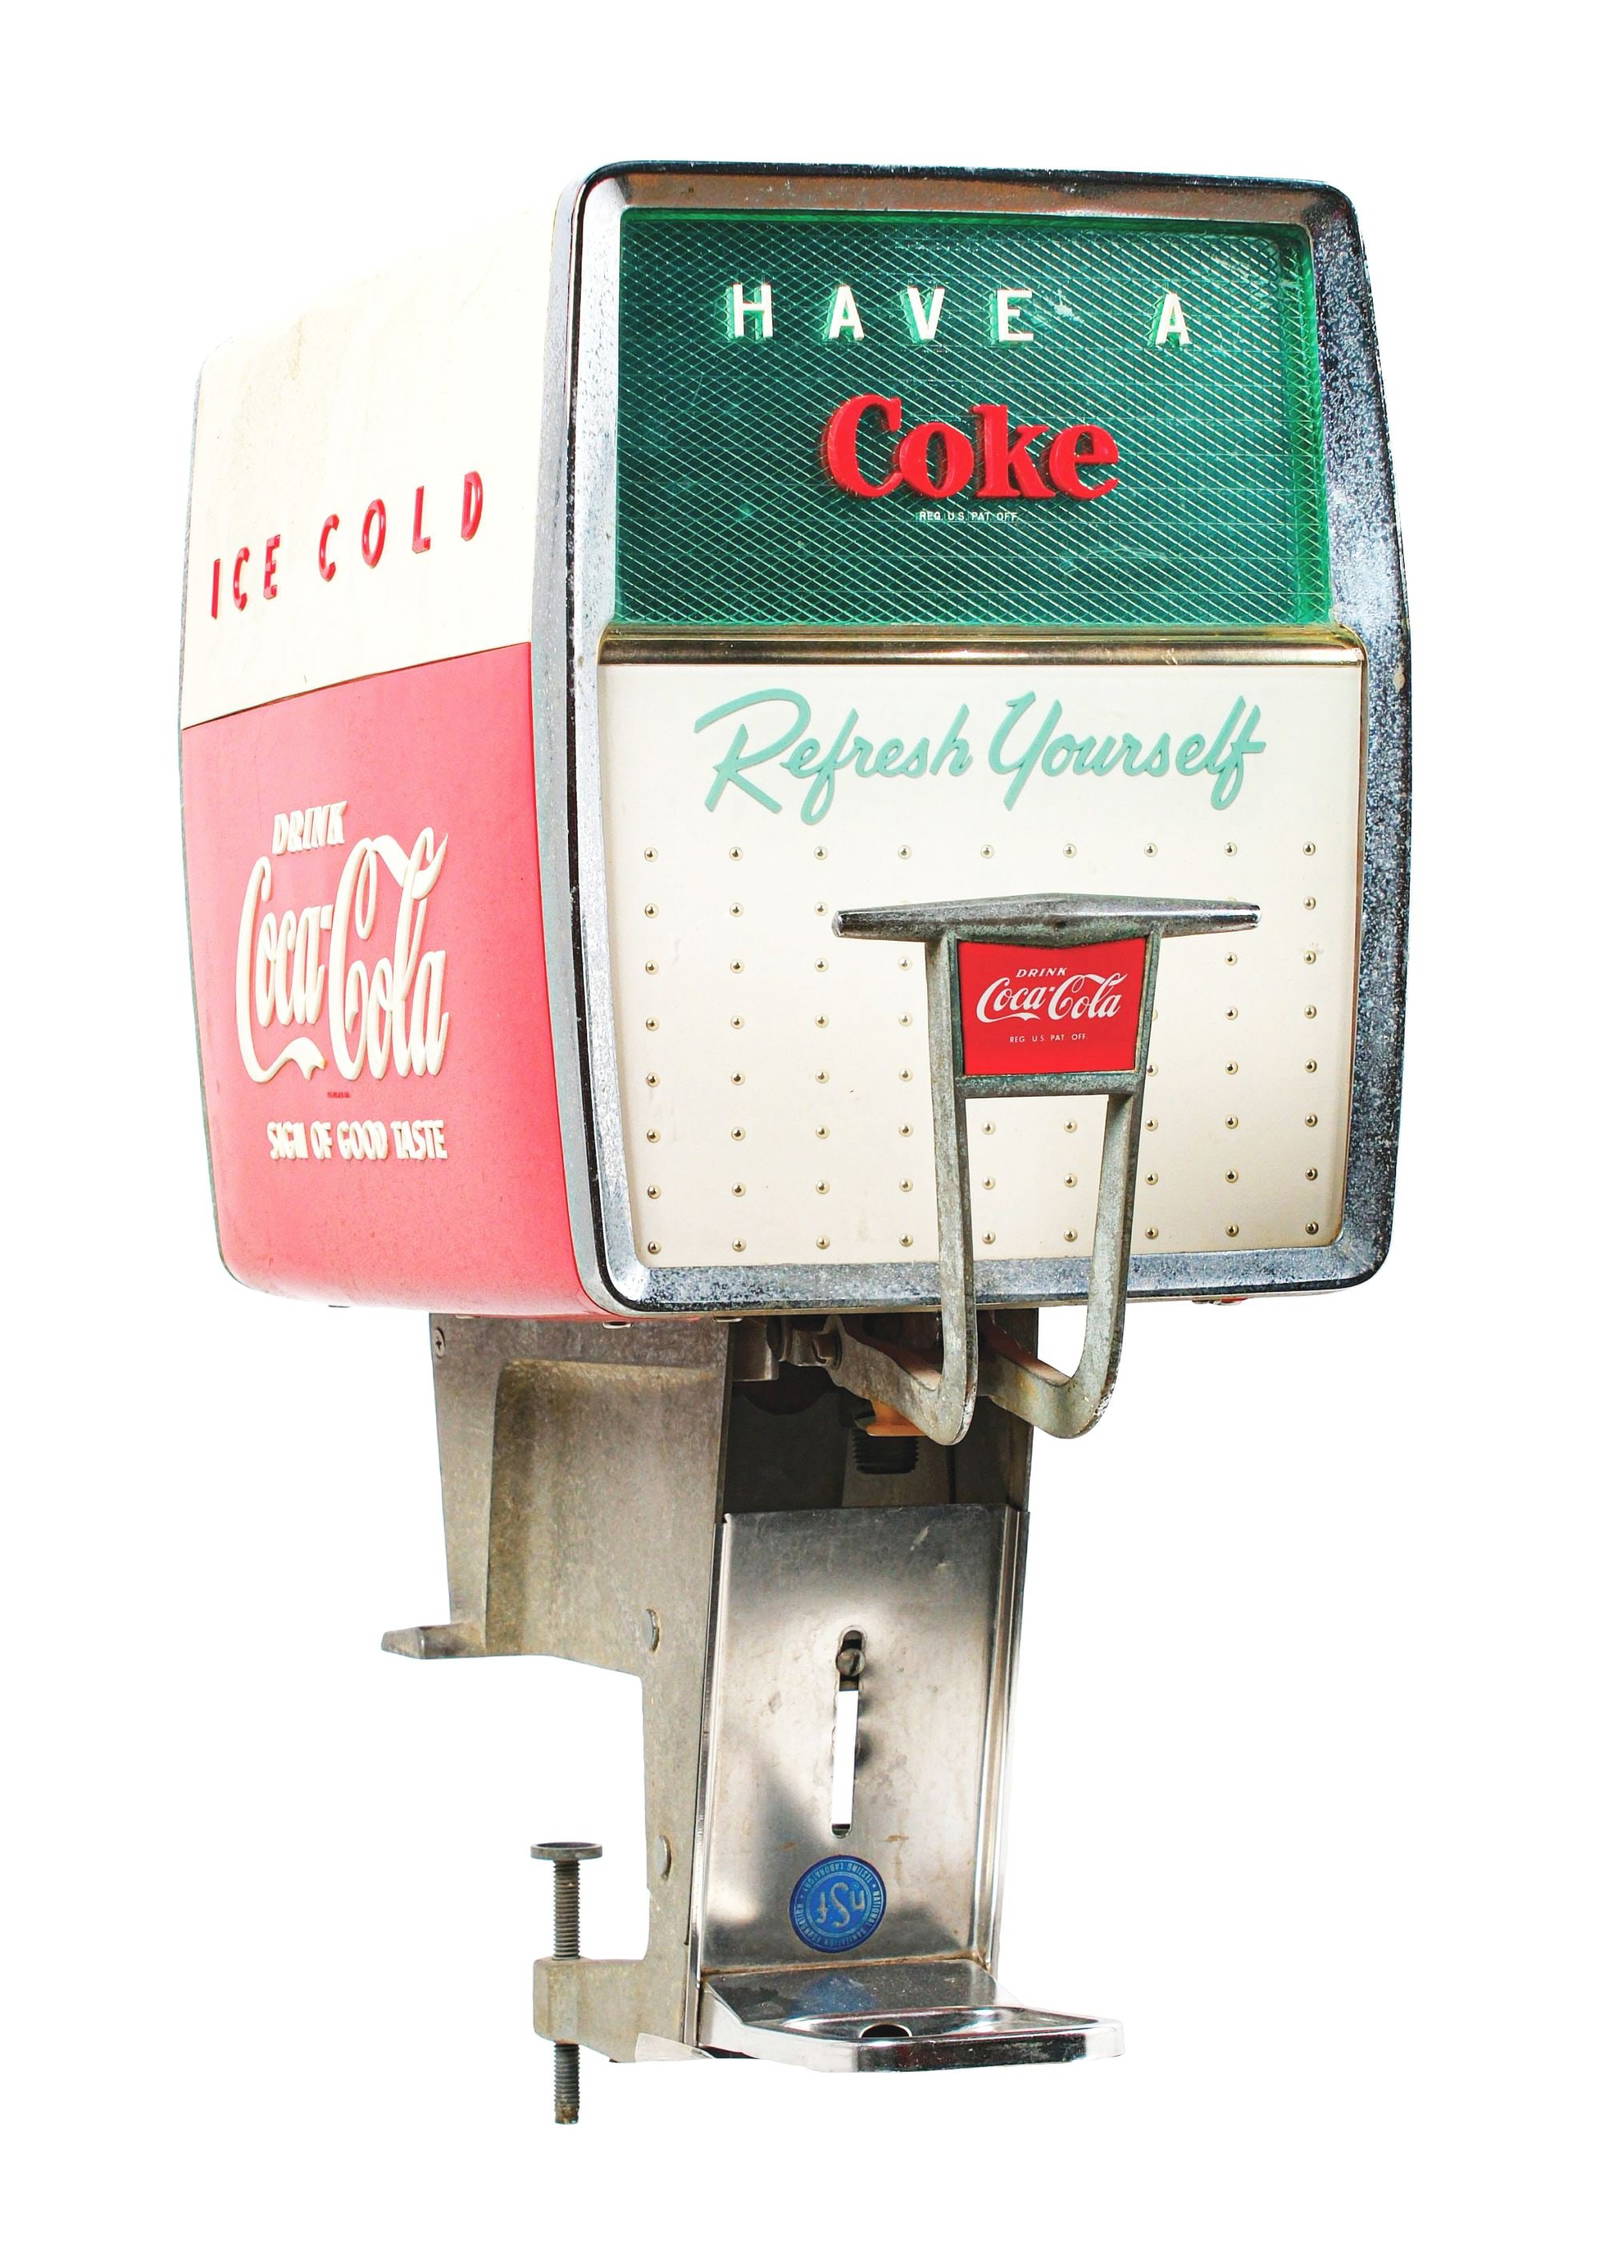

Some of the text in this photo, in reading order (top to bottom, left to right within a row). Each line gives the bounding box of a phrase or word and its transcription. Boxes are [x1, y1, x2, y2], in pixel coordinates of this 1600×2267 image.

[728, 282, 1192, 346] HAVE A
[822, 393, 1120, 500] Coke
[211, 470, 484, 620] ICE COLD
[694, 688, 1268, 825] Refresh Yourself
[272, 800, 348, 855] DRINK
[235, 826, 449, 1084] Coca-Cola
[1015, 967, 1068, 978] DRINK
[976, 972, 1128, 1023] Coca-Cola
[266, 1119, 449, 1160] SIGN OF GOOD TASTE
